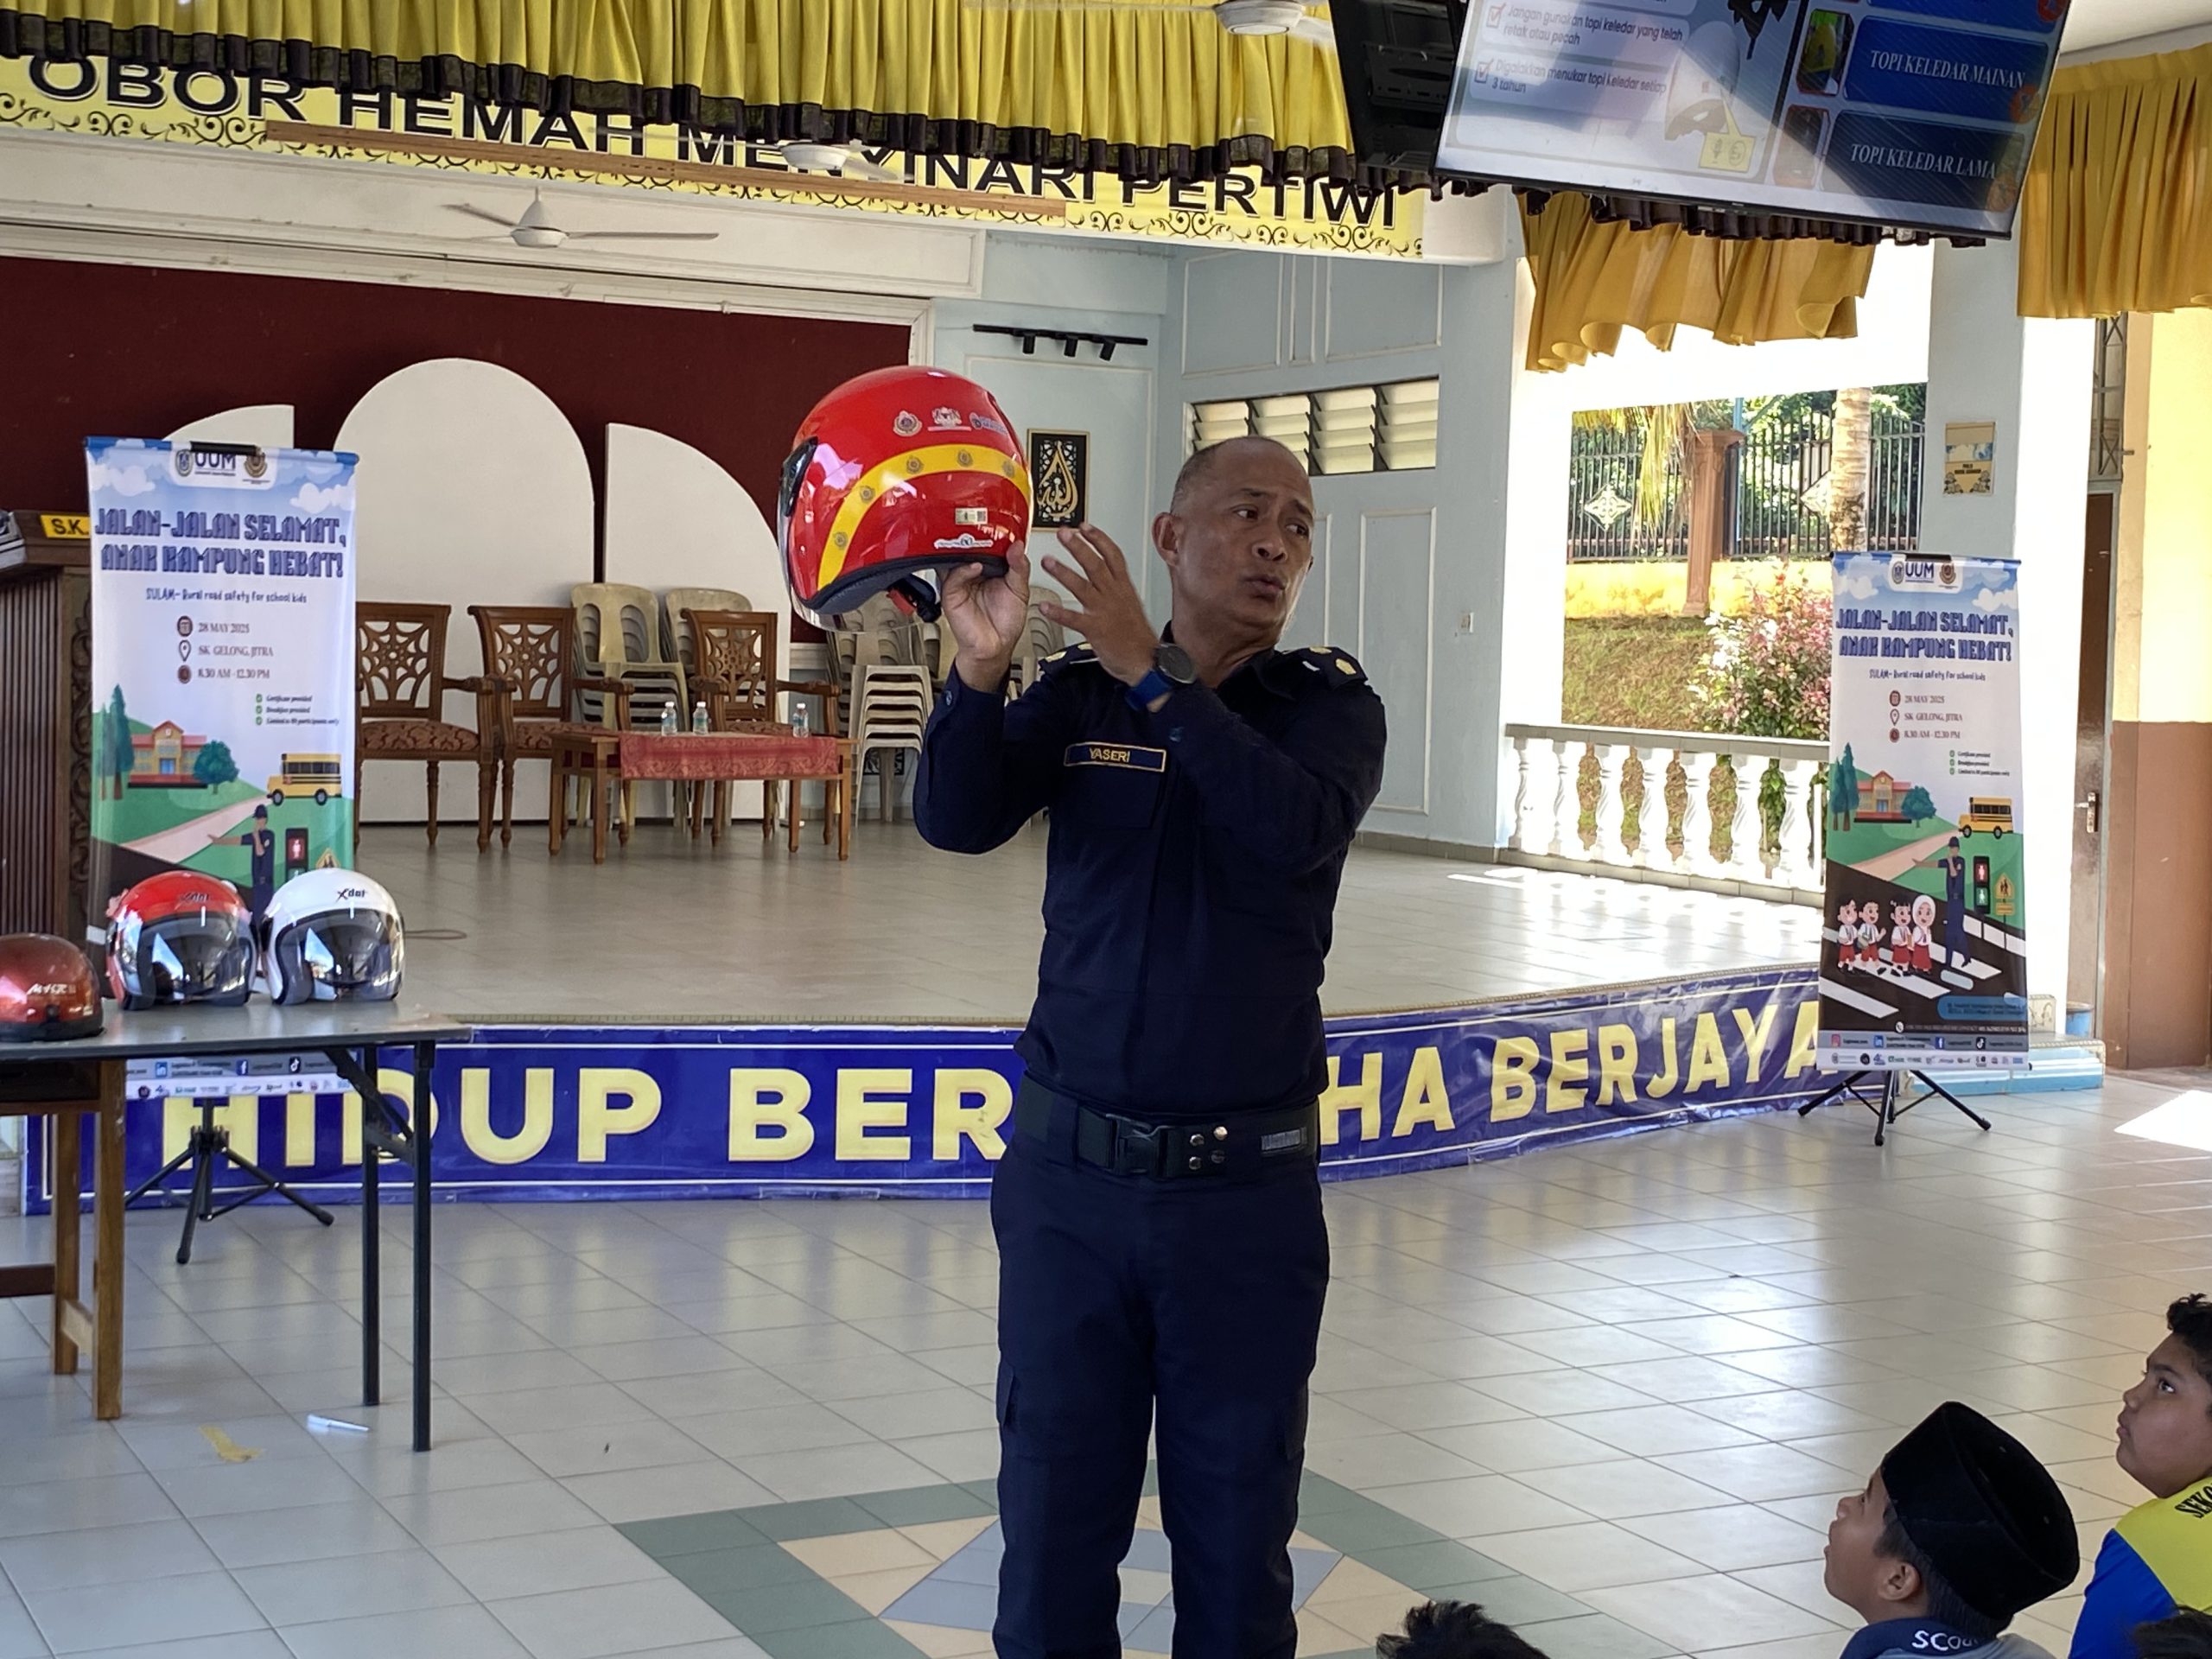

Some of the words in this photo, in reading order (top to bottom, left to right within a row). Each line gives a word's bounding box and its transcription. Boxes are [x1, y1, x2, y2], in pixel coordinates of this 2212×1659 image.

[1529, 29, 1550, 41] atau
[1552, 30, 1580, 45] pecah
[1585, 16, 1602, 31] topi
[1603, 16, 1636, 34] keledar
[1637, 24, 1660, 41] yang
[1661, 26, 1683, 41] telah
[1548, 68, 1586, 83] menukar
[1587, 71, 1605, 86] topi
[1606, 74, 1639, 91] keledar
[1640, 79, 1667, 93] setiap
[1871, 50, 1903, 71] TOPI
[1904, 54, 1969, 83] KELEDAR
[1971, 66, 2025, 88] MAINAN
[1492, 77, 1499, 89] 3
[29, 55, 309, 123] OBOR
[340, 90, 645, 157] HEMAH
[1122, 172, 1396, 229] PERTIWI
[1851, 143, 1885, 163] TOPI
[1886, 148, 1954, 174] KELEDAR
[1956, 158, 1996, 179] LAMA
[95, 508, 240, 540] JALAN-JALAN
[244, 514, 346, 547] SELAMAT,
[101, 543, 157, 572] ANAK
[162, 545, 264, 575] KAMPUNG
[269, 550, 344, 578] HEBAT!
[1905, 563, 1935, 579] UUM
[204, 589, 222, 601] road
[225, 589, 250, 604] safety
[251, 590, 264, 602] for
[266, 592, 290, 603] school
[292, 593, 307, 604] kids
[198, 622, 209, 633] 28
[210, 622, 228, 633] MAY
[230, 623, 251, 633] 2025
[1836, 608, 1937, 632] JALAN-JALAN
[1940, 612, 2014, 638] SELAMAT,
[198, 645, 210, 656] SK
[1839, 635, 1878, 658] ANAK
[1881, 637, 1955, 659] KAMPUNG
[1958, 639, 2012, 662] HEBAT!
[216, 669, 231, 678] AM
[257, 670, 270, 679] PM
[1090, 747, 1130, 763] YASERI
[1491, 1001, 1839, 1123] BERJAYA
